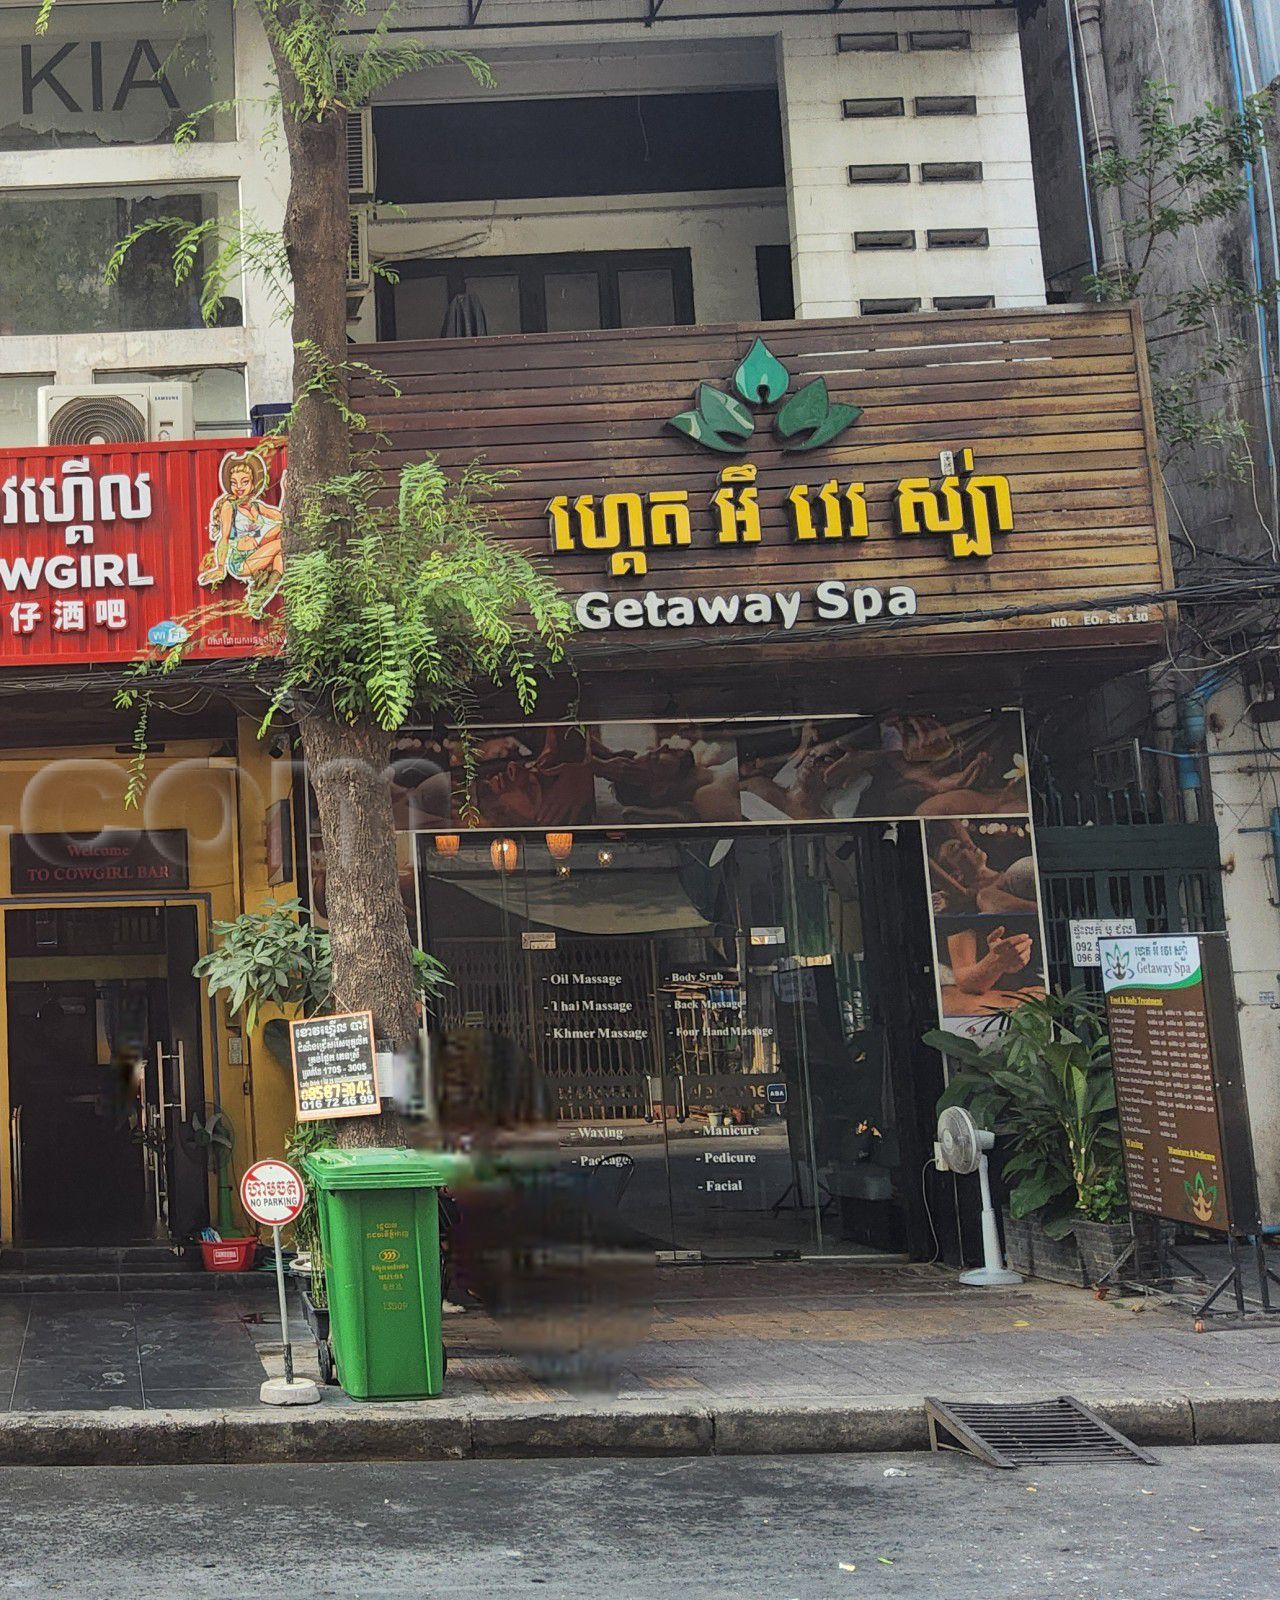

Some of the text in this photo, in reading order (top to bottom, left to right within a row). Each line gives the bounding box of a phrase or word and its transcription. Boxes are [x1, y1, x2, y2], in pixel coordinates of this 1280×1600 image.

[21, 39, 180, 115] KIA
[576, 581, 918, 630] Getaway Spa
[67, 844, 129, 857] Welcome
[27, 865, 170, 881] TO COWGIRL BAR
[1136, 961, 1192, 977] Getaway Spa
[550, 974, 622, 987] Oil Massage
[672, 972, 696, 983] Body
[581, 1001, 633, 1013] Massage
[553, 1028, 649, 1041] Khmer Massage
[702, 1026, 729, 1036] Hand
[302, 1094, 374, 1110] 016 72 46 99
[578, 1127, 624, 1141] Waxing
[702, 1125, 760, 1136] Manicure
[704, 1152, 756, 1164] Pedicure
[706, 1180, 743, 1192] Facial
[251, 1197, 297, 1207] NO PARKING
